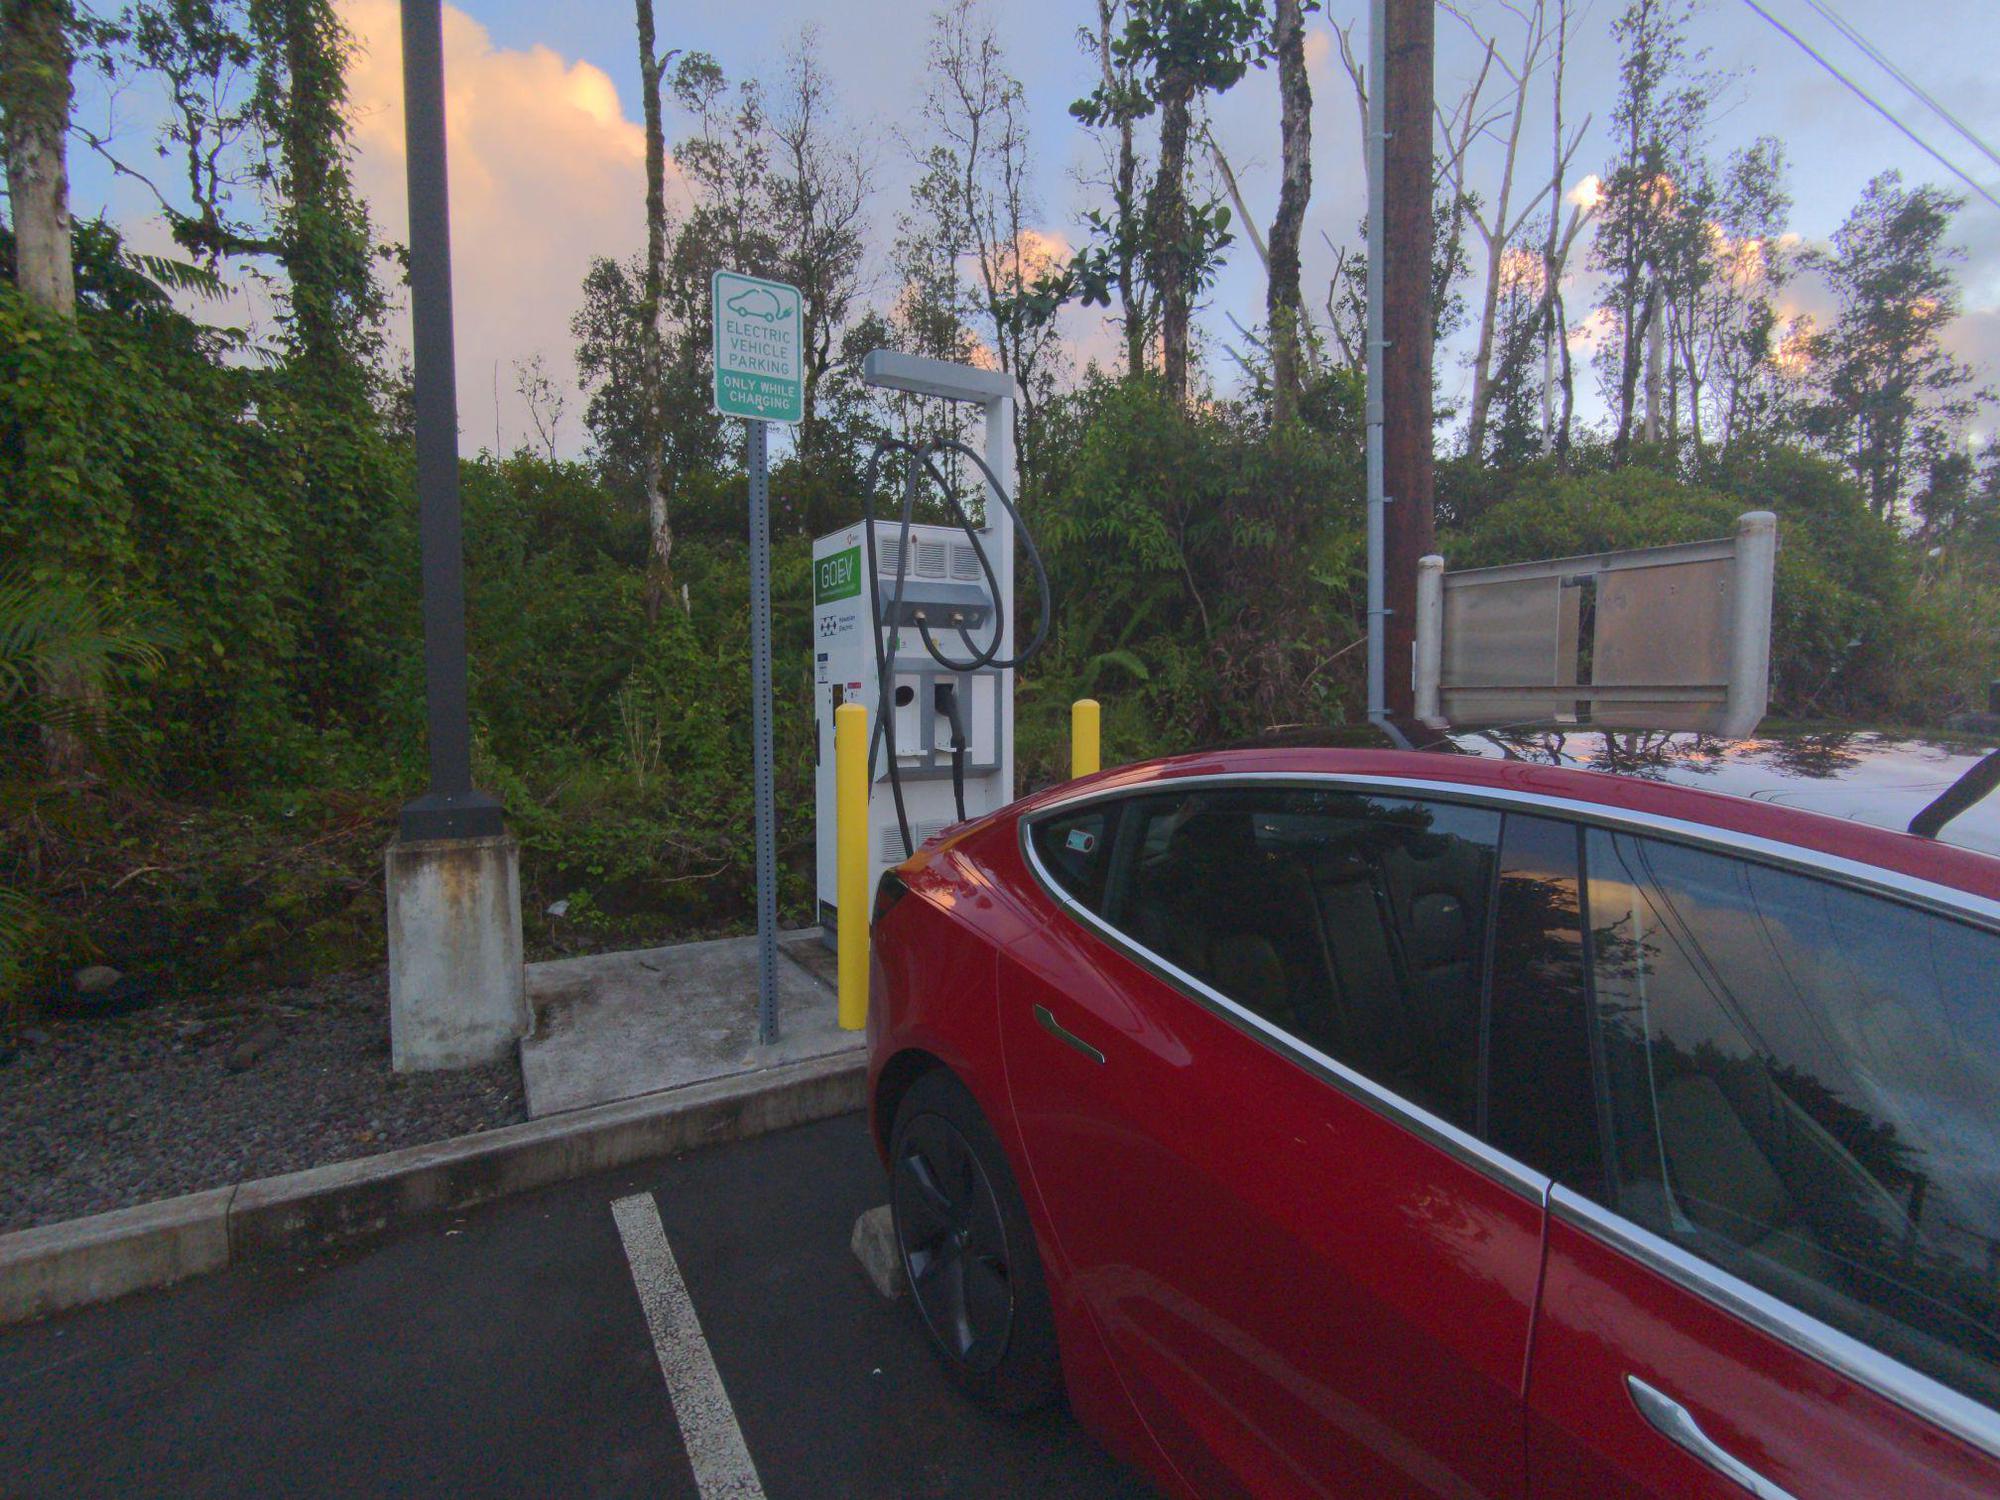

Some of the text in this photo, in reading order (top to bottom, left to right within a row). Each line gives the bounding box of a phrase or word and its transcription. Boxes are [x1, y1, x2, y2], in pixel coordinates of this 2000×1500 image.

[727, 320, 791, 343] ELECTRIC
[730, 337, 788, 359] VEHICLE
[729, 353, 789, 375] PARKING
[724, 375, 795, 398] ONLY WHILE
[730, 391, 791, 409] CHARGING
